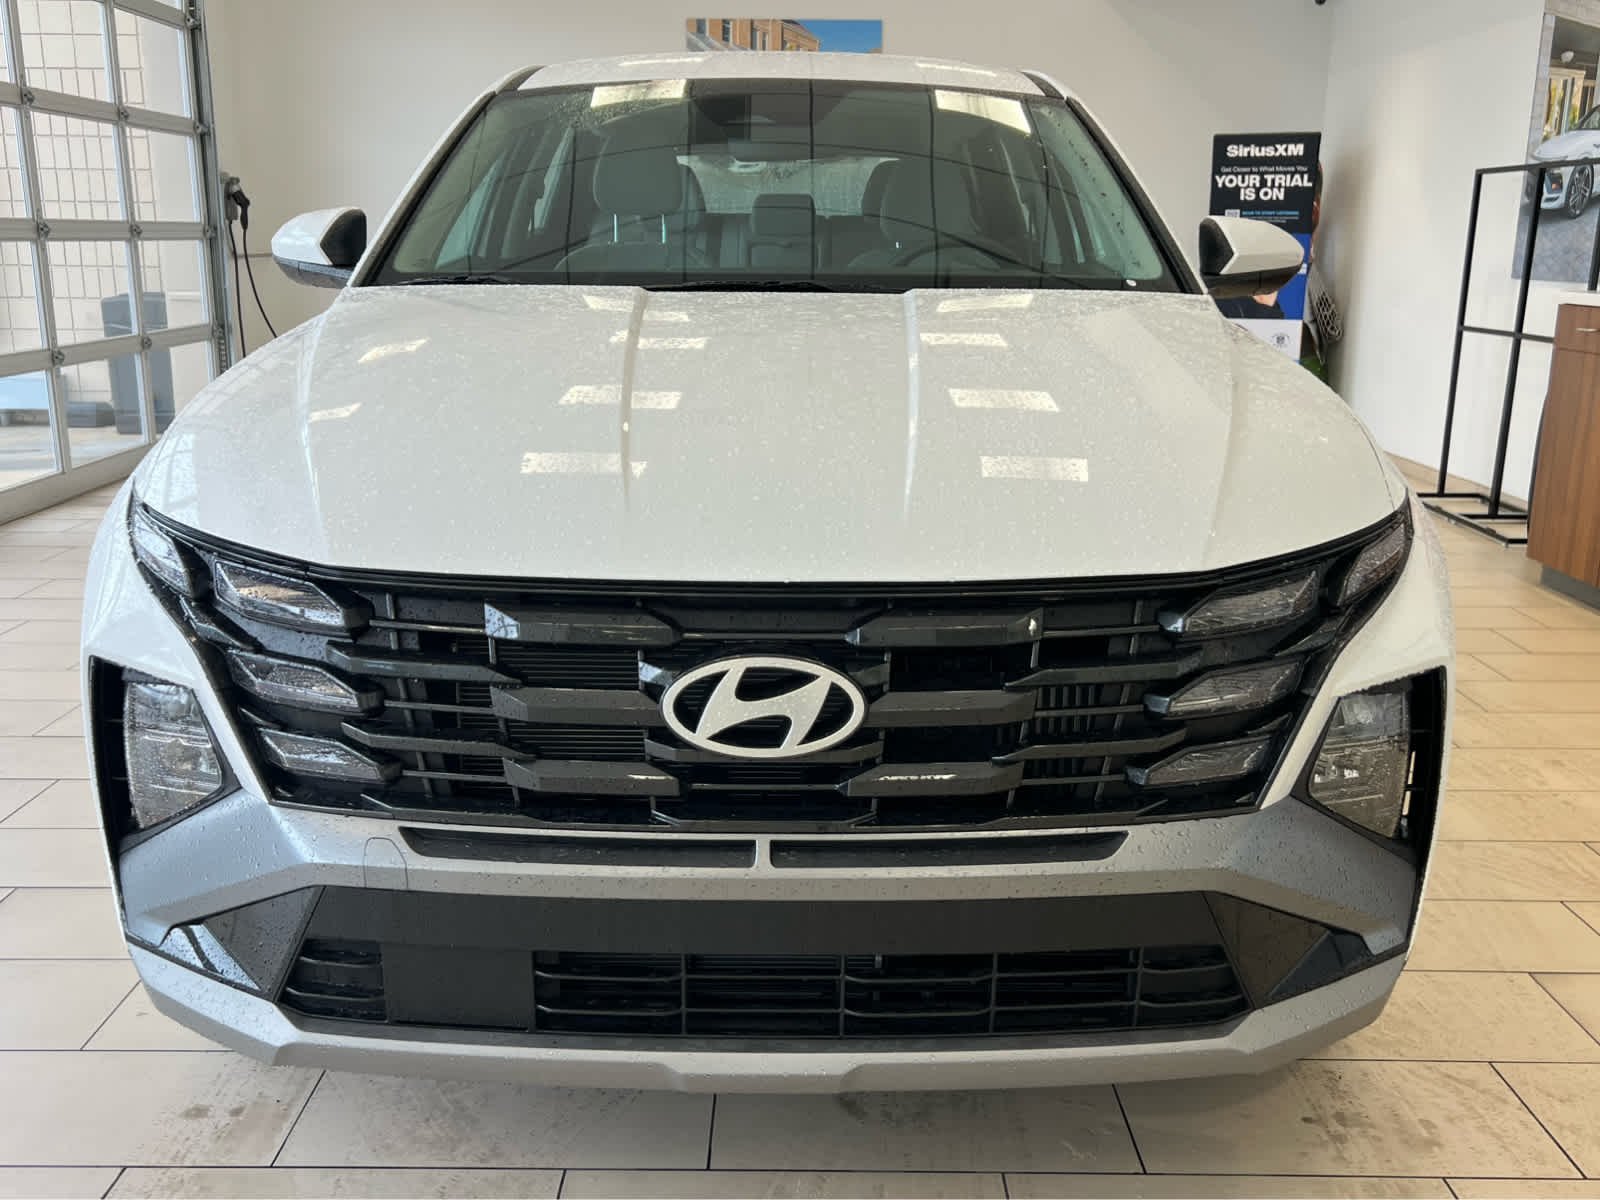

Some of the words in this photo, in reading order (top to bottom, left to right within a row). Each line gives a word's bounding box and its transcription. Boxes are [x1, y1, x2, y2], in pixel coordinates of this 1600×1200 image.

[1226, 143, 1304, 157] SiriusXM
[1215, 174, 1260, 188] YOUR
[1264, 174, 1312, 187] TRIAL
[1240, 188, 1256, 201] IS
[1259, 188, 1285, 201] ON
